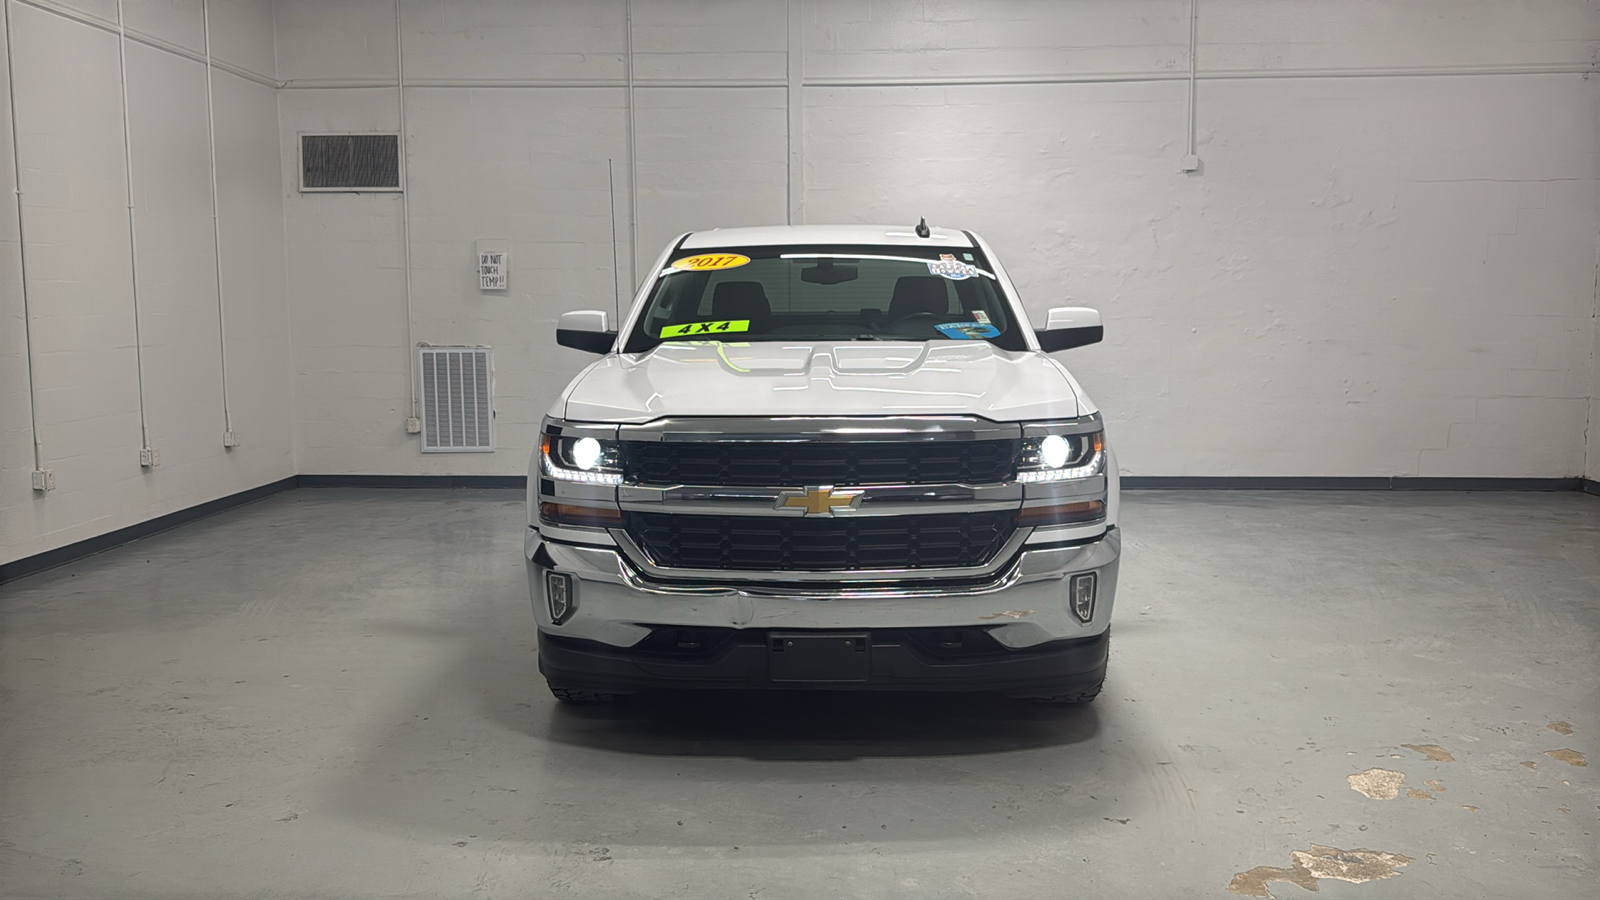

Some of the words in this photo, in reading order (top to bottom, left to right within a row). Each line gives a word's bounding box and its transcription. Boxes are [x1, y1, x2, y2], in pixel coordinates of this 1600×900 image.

[481, 254, 489, 265] DO
[490, 254, 503, 265] NOT
[688, 256, 738, 268] 2017
[481, 265, 499, 275] TOUCH
